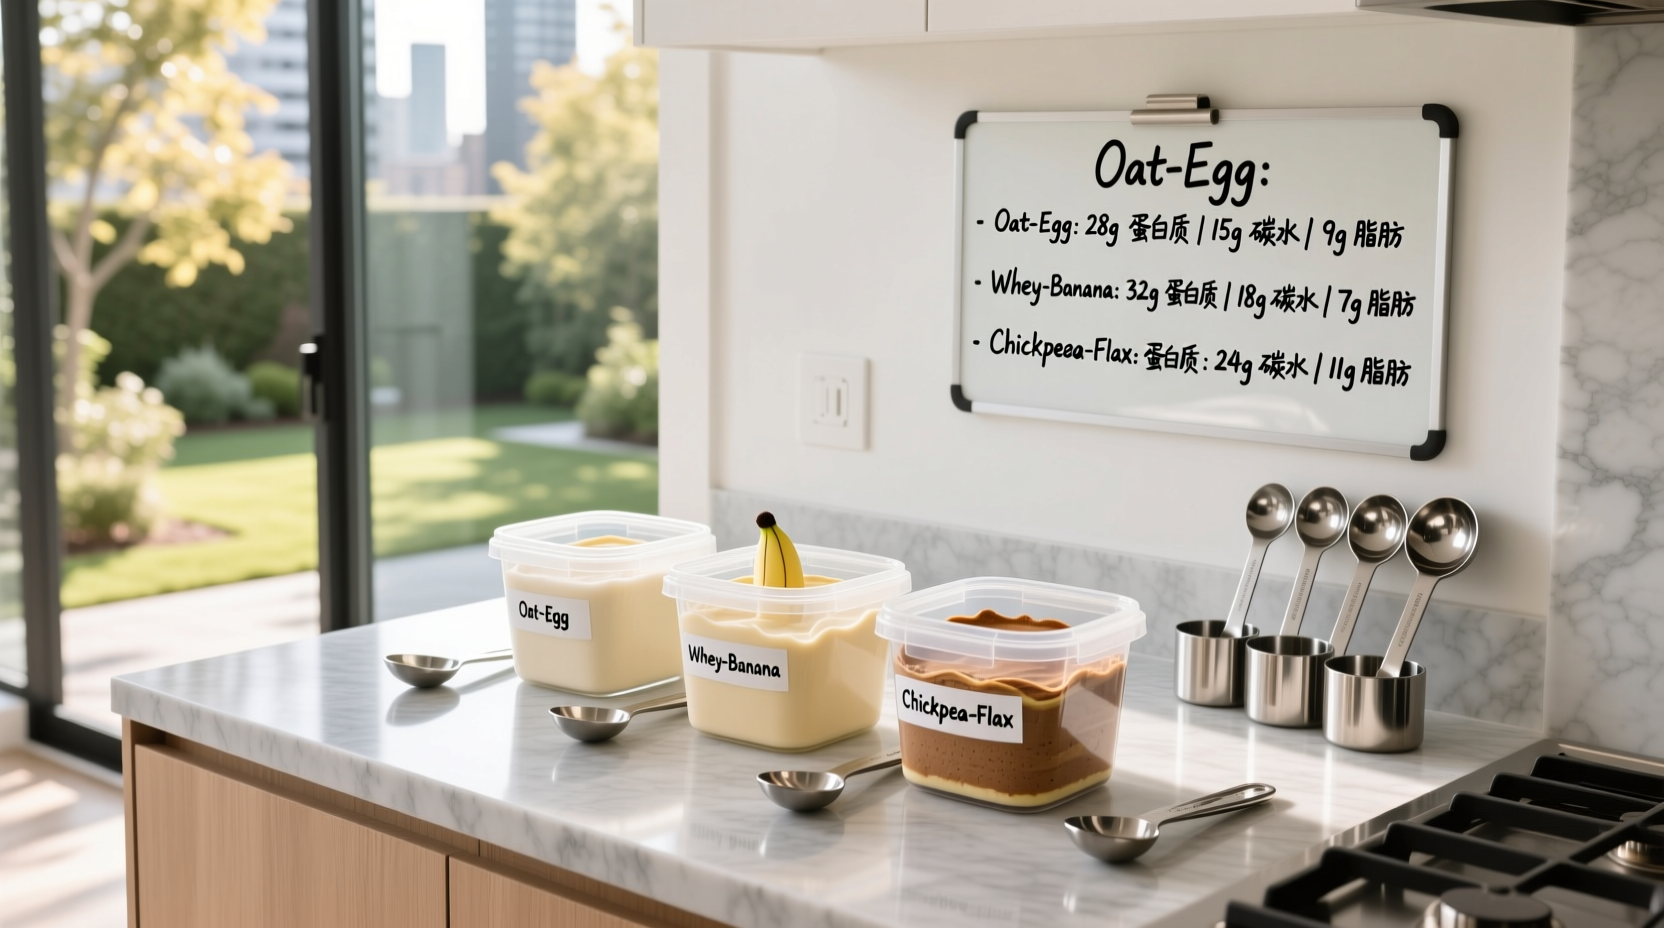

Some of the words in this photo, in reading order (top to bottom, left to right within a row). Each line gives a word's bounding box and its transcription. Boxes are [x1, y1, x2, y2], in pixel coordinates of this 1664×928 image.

[1095, 139, 1269, 207] Oat-Egg:
[995, 208, 1078, 244] Oat-Egg:
[1085, 214, 1119, 246] 28g
[1129, 214, 1190, 244] 蛋白质
[1212, 218, 1242, 253] 15g
[1249, 216, 1300, 246] 碳水
[1323, 220, 1346, 256] 9g
[1354, 219, 1404, 248] 脂肪
[992, 267, 1119, 306] Whey-Banana:
[1126, 279, 1159, 312] 32g
[1165, 279, 1217, 309] 蛋白质
[1238, 284, 1266, 319] 18g
[1270, 284, 1319, 312] 碳水
[1338, 289, 1361, 324] 7g
[1367, 288, 1416, 317] 脂肪
[1214, 350, 1252, 385] 24g
[1258, 350, 1308, 379] 碳水
[1329, 357, 1355, 391] 11g
[1360, 357, 1411, 386] 脂肪
[519, 601, 569, 631] Oat-Egg
[689, 645, 780, 678] Whey-Banana
[903, 688, 1014, 730] Chickpea-Flax
